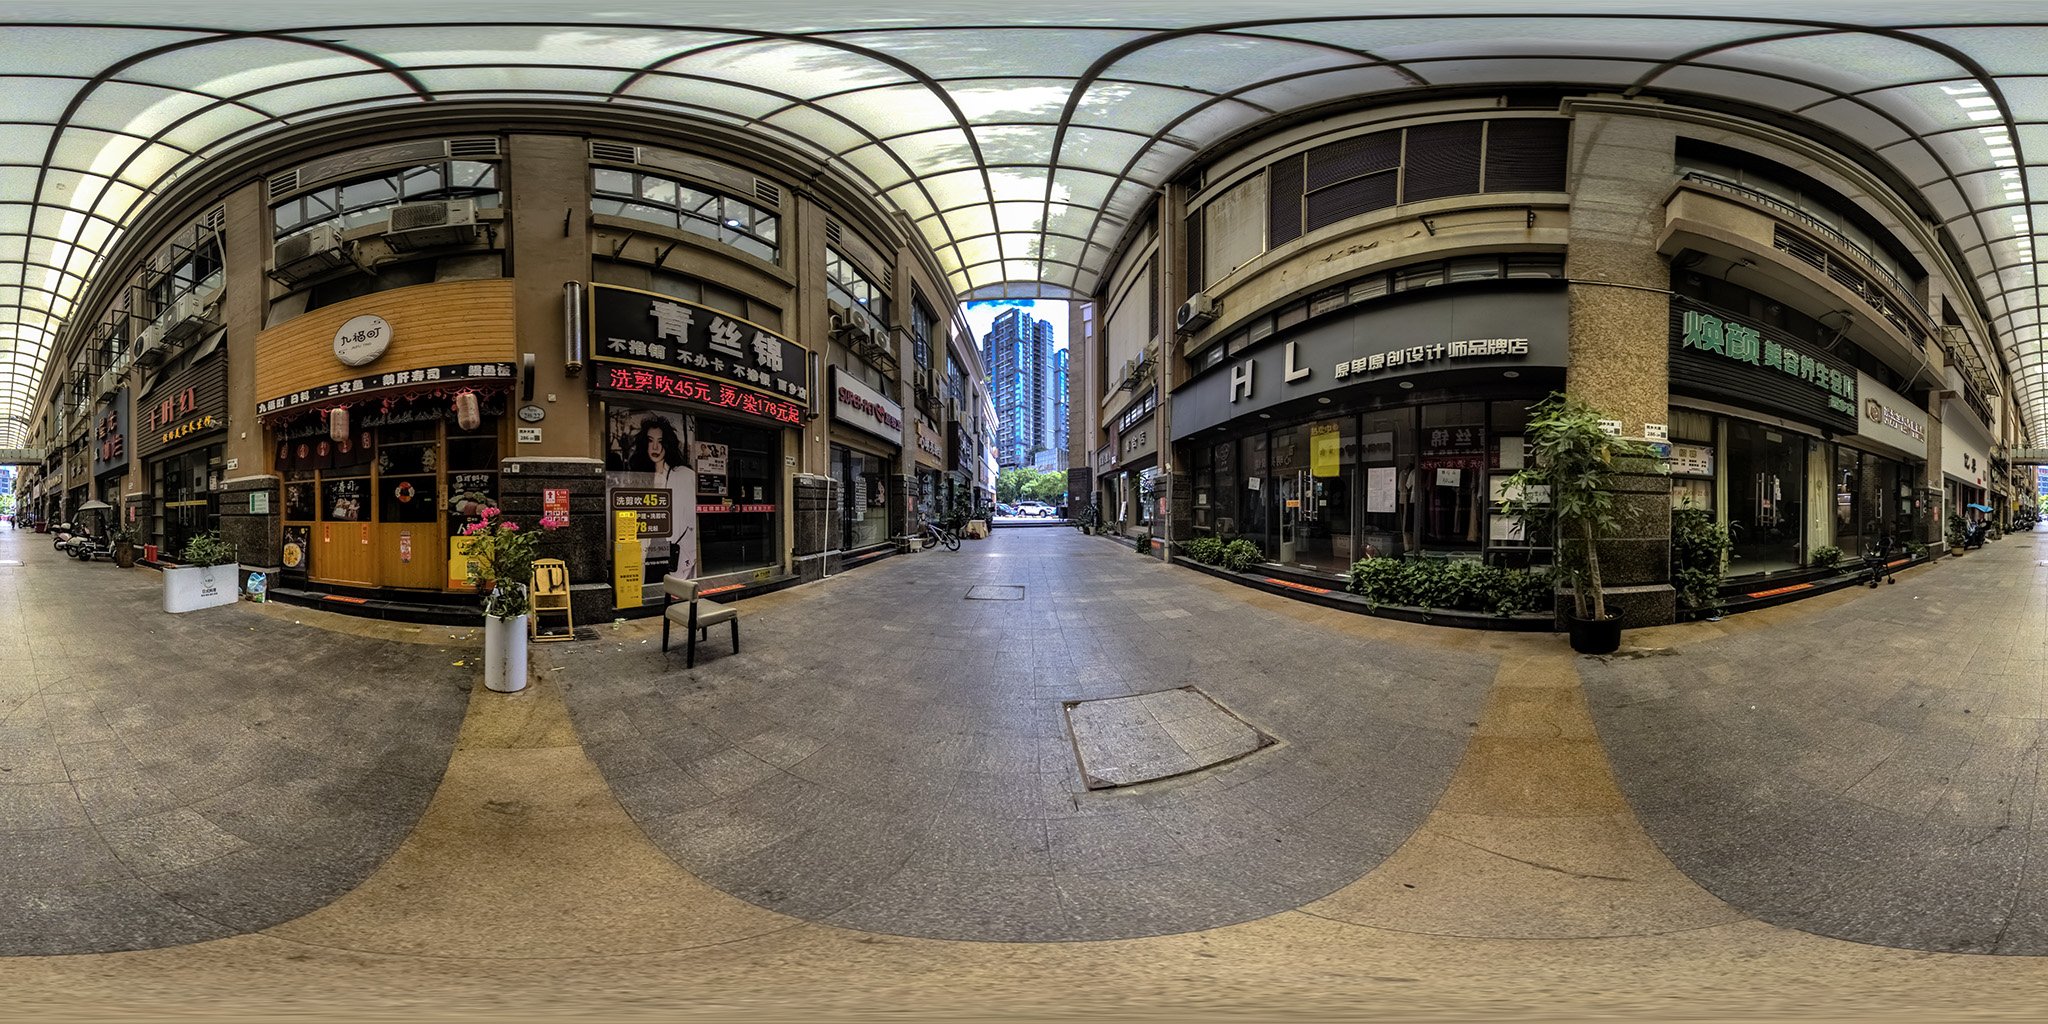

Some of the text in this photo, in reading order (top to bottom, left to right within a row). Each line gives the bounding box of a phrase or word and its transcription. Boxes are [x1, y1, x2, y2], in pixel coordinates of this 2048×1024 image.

[607, 337, 667, 361] 不推销
[676, 348, 725, 372] 不办卡
[649, 300, 784, 373] 青丝锦
[1334, 338, 1529, 380] 原单原创设计师品牌店
[290, 391, 311, 405] 日料
[327, 379, 365, 396] 三文鱼
[610, 368, 801, 423] 洗剪吹45元 烫/染178元起
[615, 494, 668, 507] 洗剪吹45元
